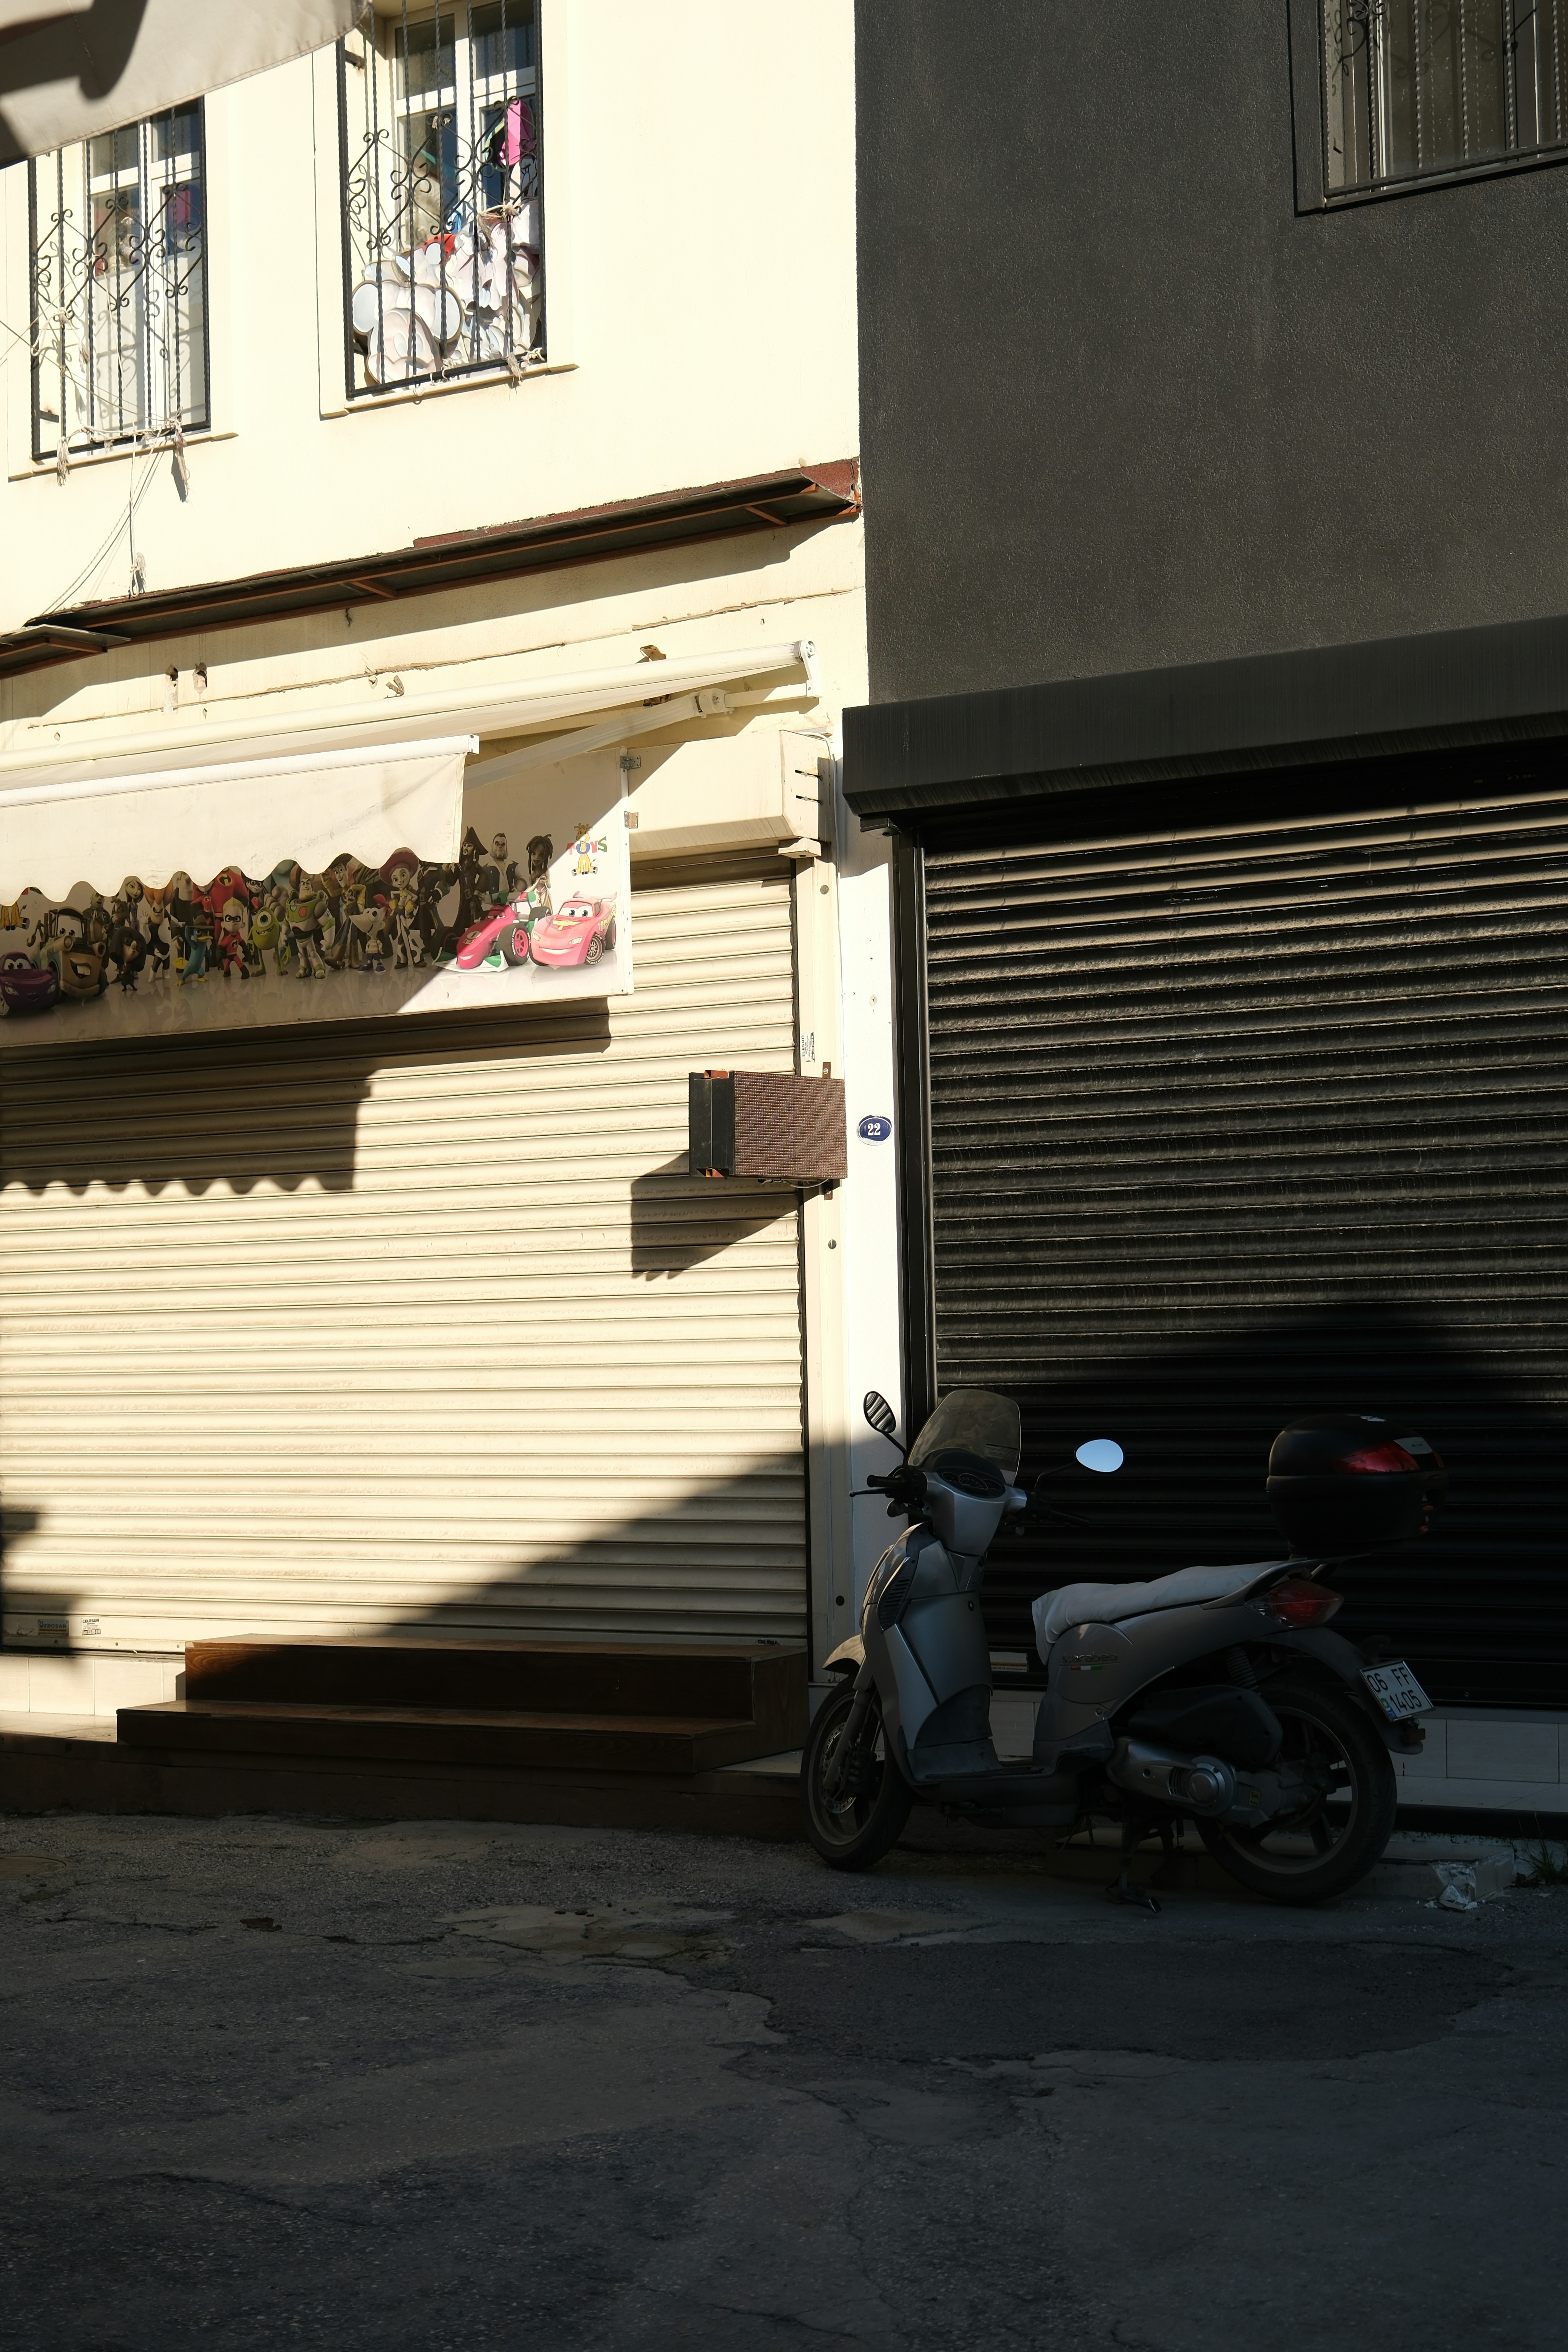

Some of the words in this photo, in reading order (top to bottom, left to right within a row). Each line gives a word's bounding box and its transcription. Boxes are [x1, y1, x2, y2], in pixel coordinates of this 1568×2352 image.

[566, 836, 607, 855] TOYS
[867, 1123, 881, 1136] 22
[1061, 1651, 1118, 1663] scarabeo
[1367, 1673, 1388, 1693] 06
[1391, 1667, 1409, 1687] FF
[1389, 1690, 1422, 1713] 1405
